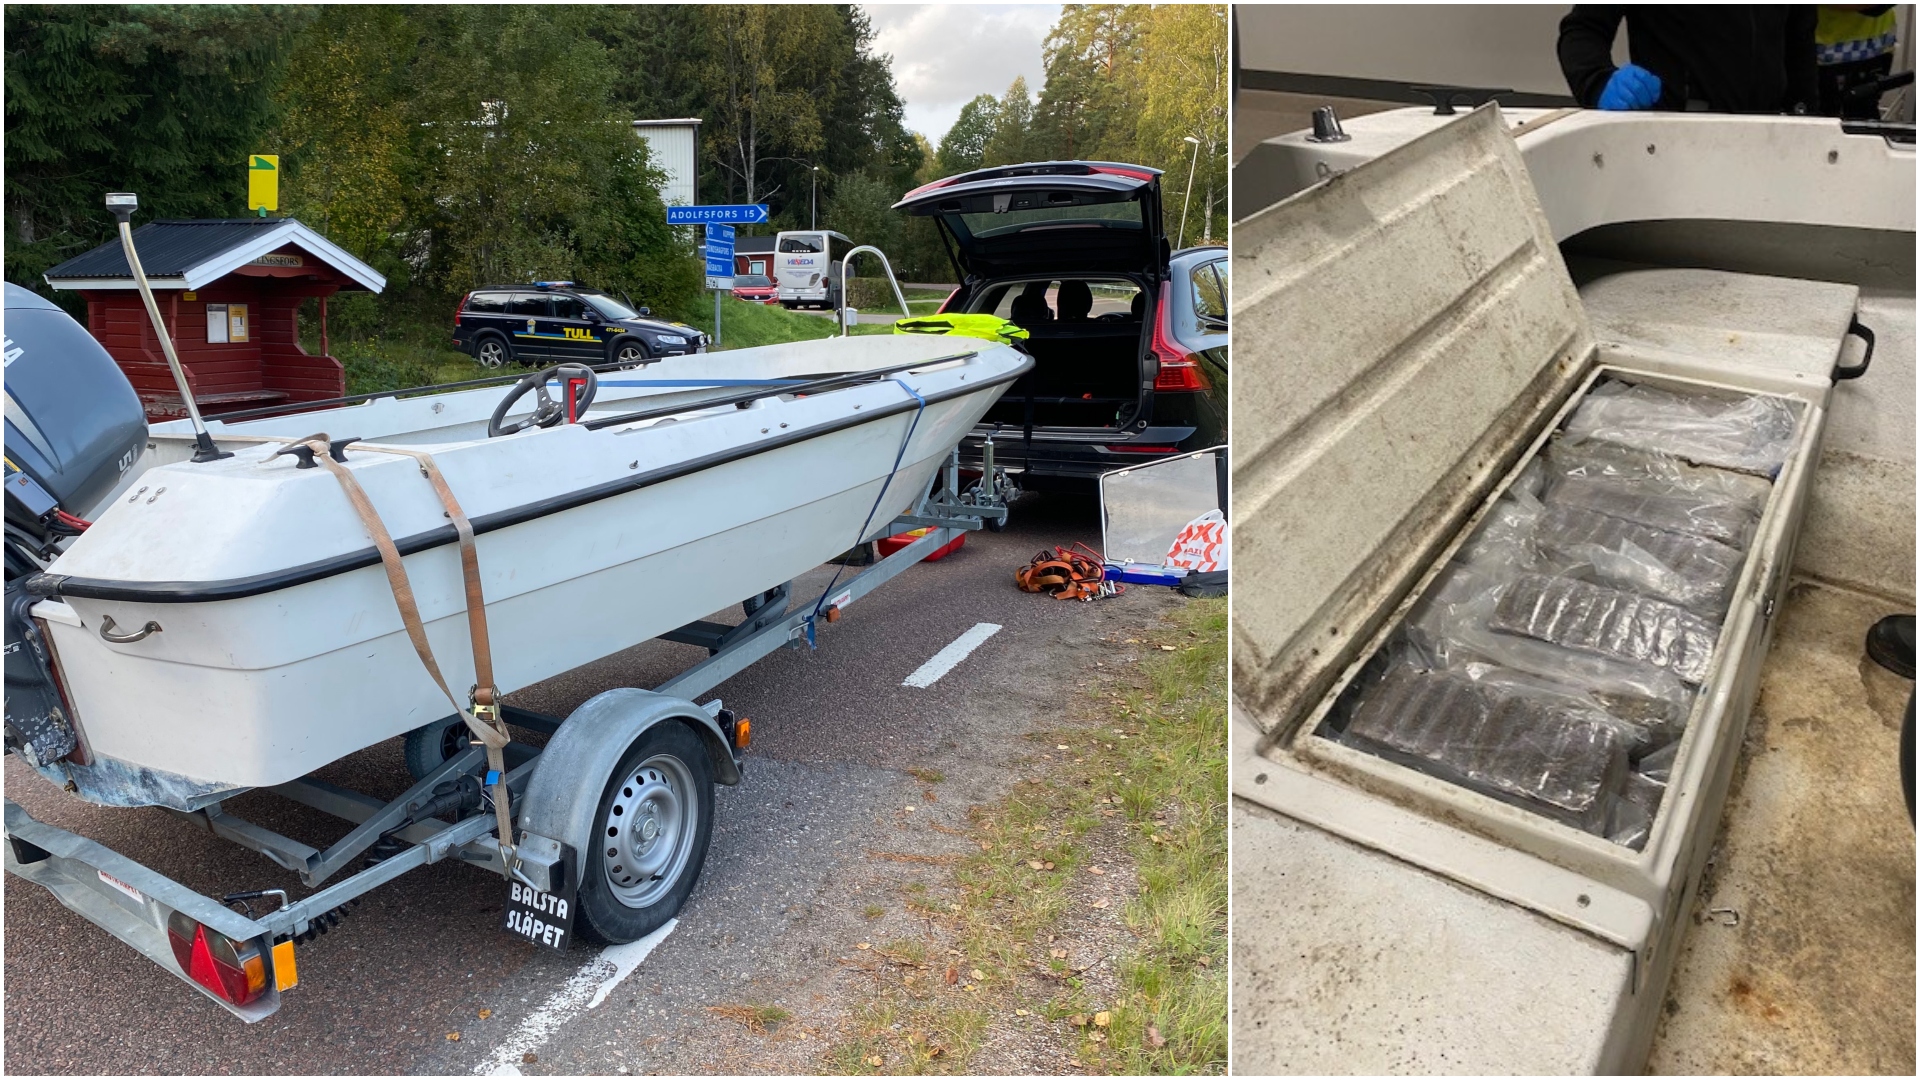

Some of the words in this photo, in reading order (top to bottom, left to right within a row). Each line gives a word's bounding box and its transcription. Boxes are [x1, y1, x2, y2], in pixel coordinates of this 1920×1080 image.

[670, 210, 738, 219] ADOLFSFORS
[744, 209, 755, 218] 15
[563, 327, 594, 340] TULL
[506, 909, 565, 949] SLÄPET
